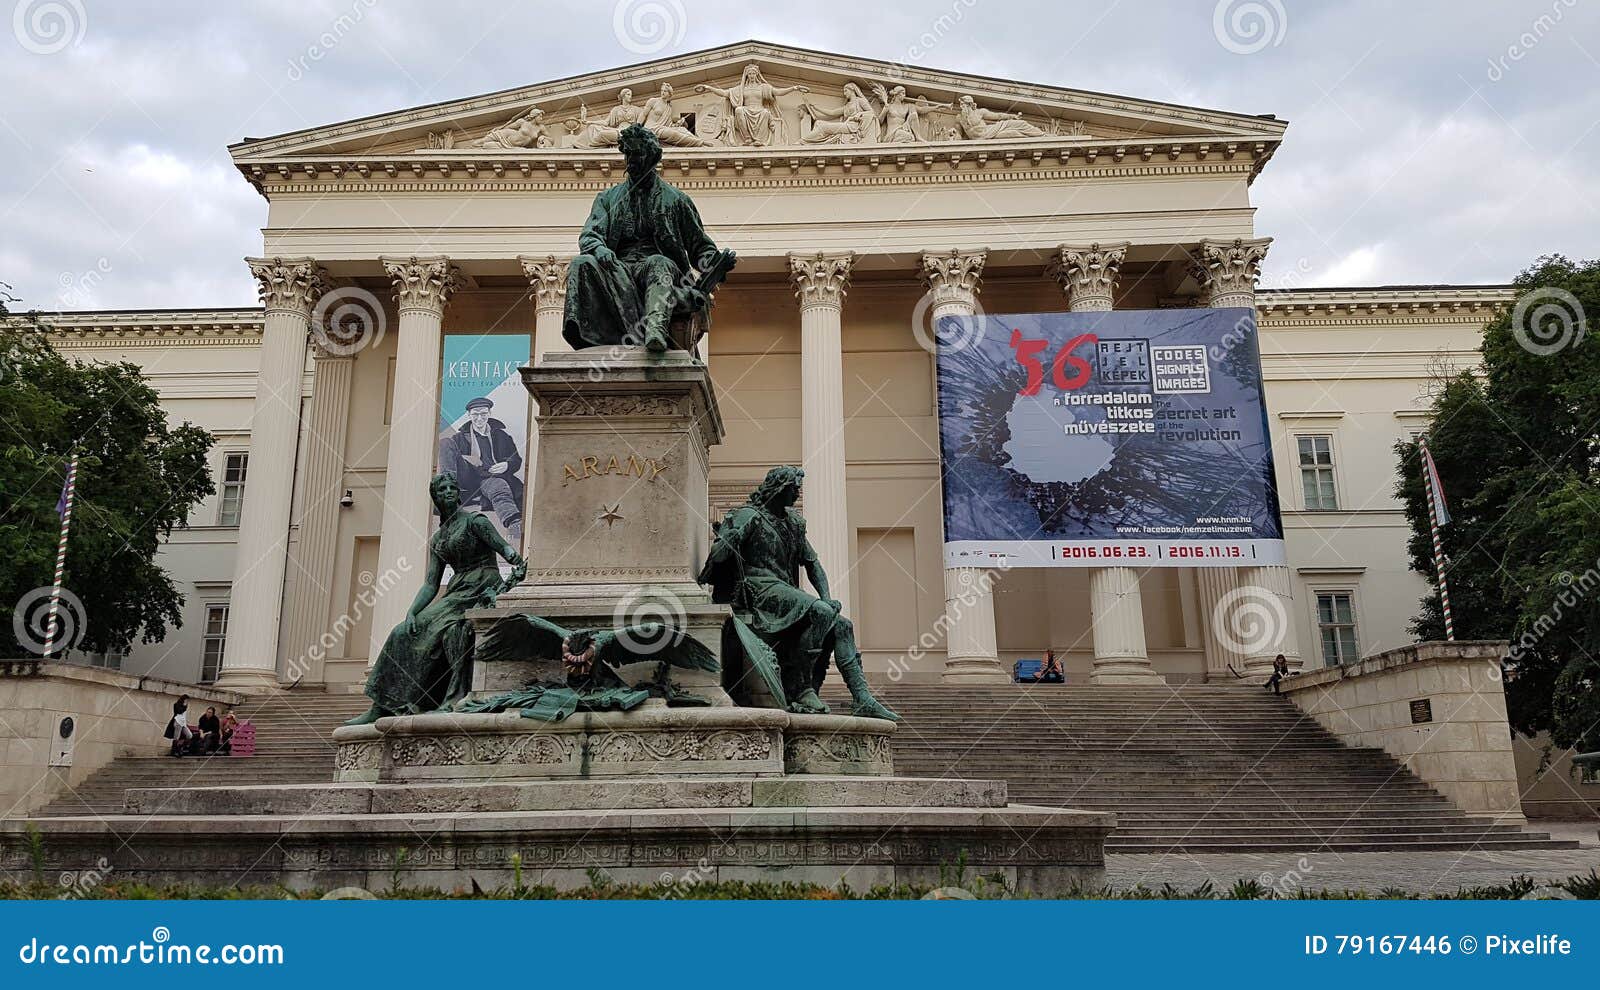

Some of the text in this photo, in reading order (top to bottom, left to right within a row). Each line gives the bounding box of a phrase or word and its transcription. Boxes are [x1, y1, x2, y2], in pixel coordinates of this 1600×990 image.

[1154, 350, 1203, 361] CODES
[1009, 328, 1098, 396] '56
[1102, 368, 1147, 380] KÉPEK
[1156, 364, 1205, 375] SIGNALS
[1158, 378, 1206, 390] IMAGES
[1064, 392, 1153, 406] forradalom
[1107, 407, 1154, 420] titkos
[1156, 406, 1236, 420] secret art
[1064, 420, 1155, 434] művészete
[1168, 422, 1184, 430] the
[1158, 428, 1242, 442] revolution
[562, 454, 671, 488] ARANY
[1196, 516, 1252, 524] www.hnm.hu
[1062, 546, 1245, 558] 2016.06.23. 2016.11.13.
